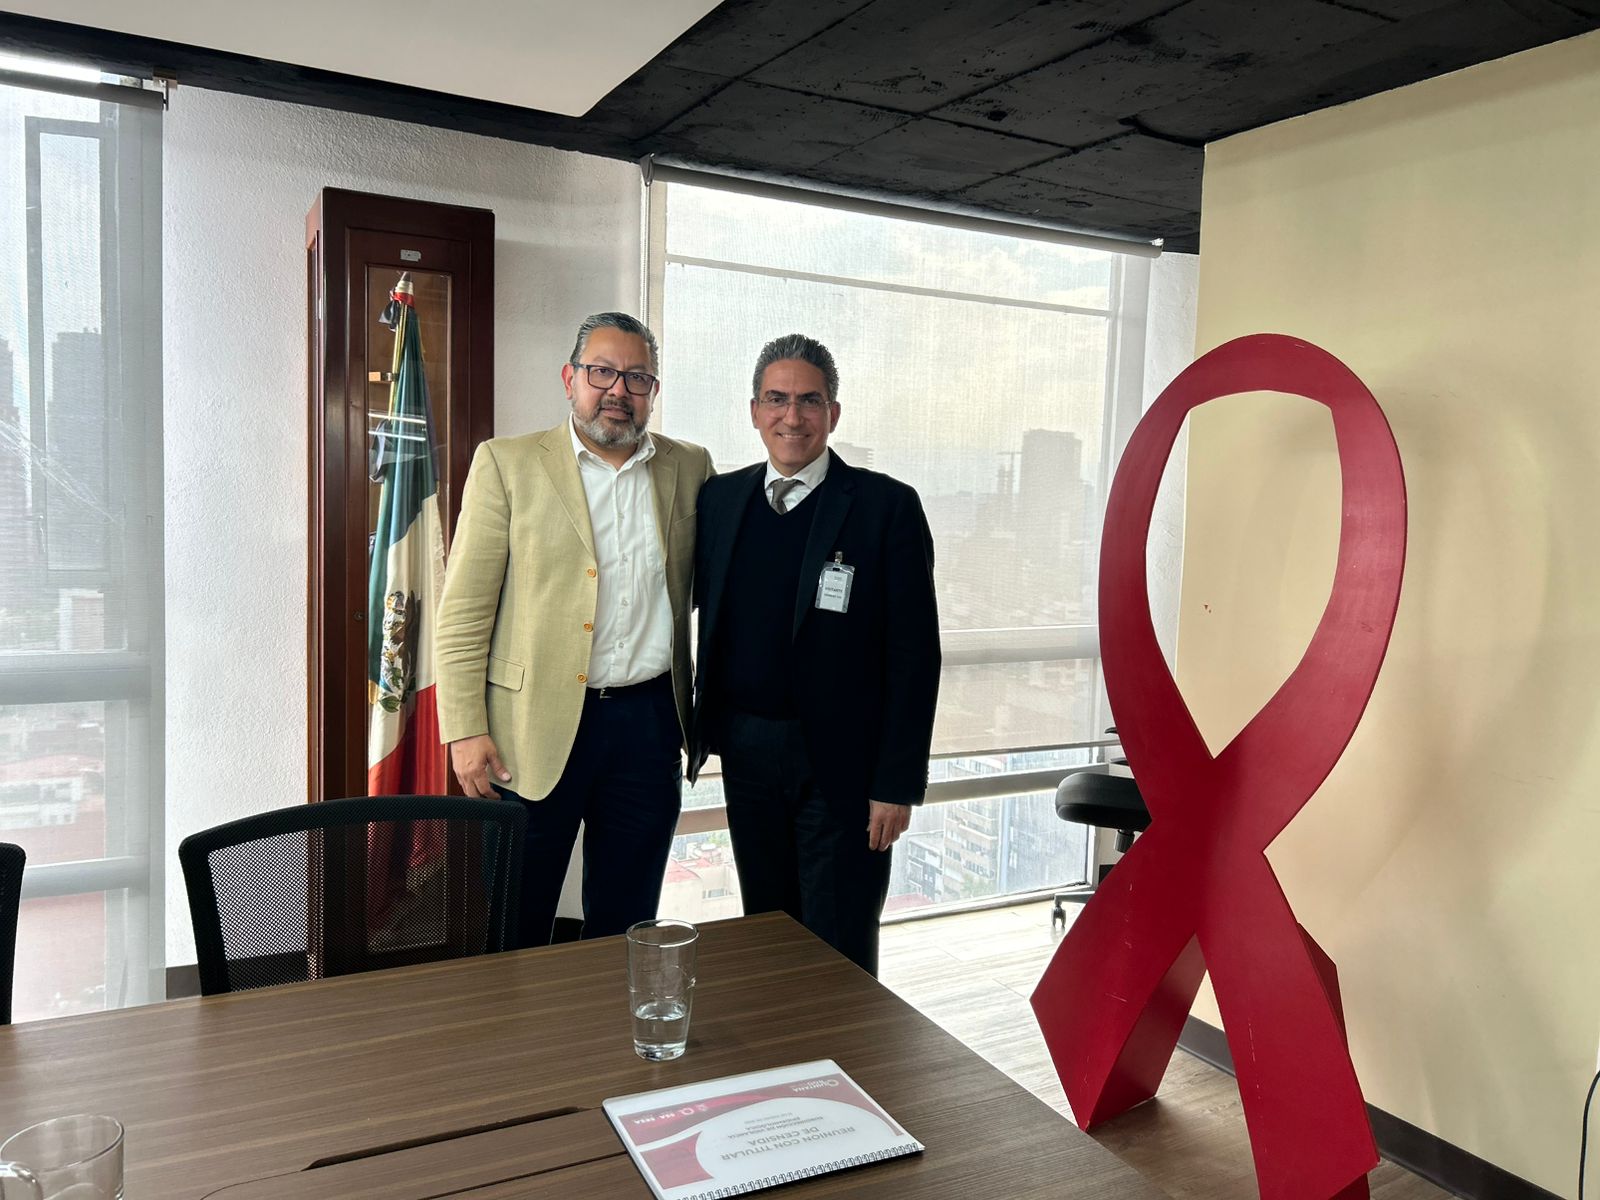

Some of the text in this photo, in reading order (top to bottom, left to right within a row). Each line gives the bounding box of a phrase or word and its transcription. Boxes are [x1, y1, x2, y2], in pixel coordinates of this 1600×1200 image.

[747, 1126, 819, 1145] DE CENSIDA
[773, 1138, 800, 1149] CON
[720, 1144, 772, 1160] TITULAR
